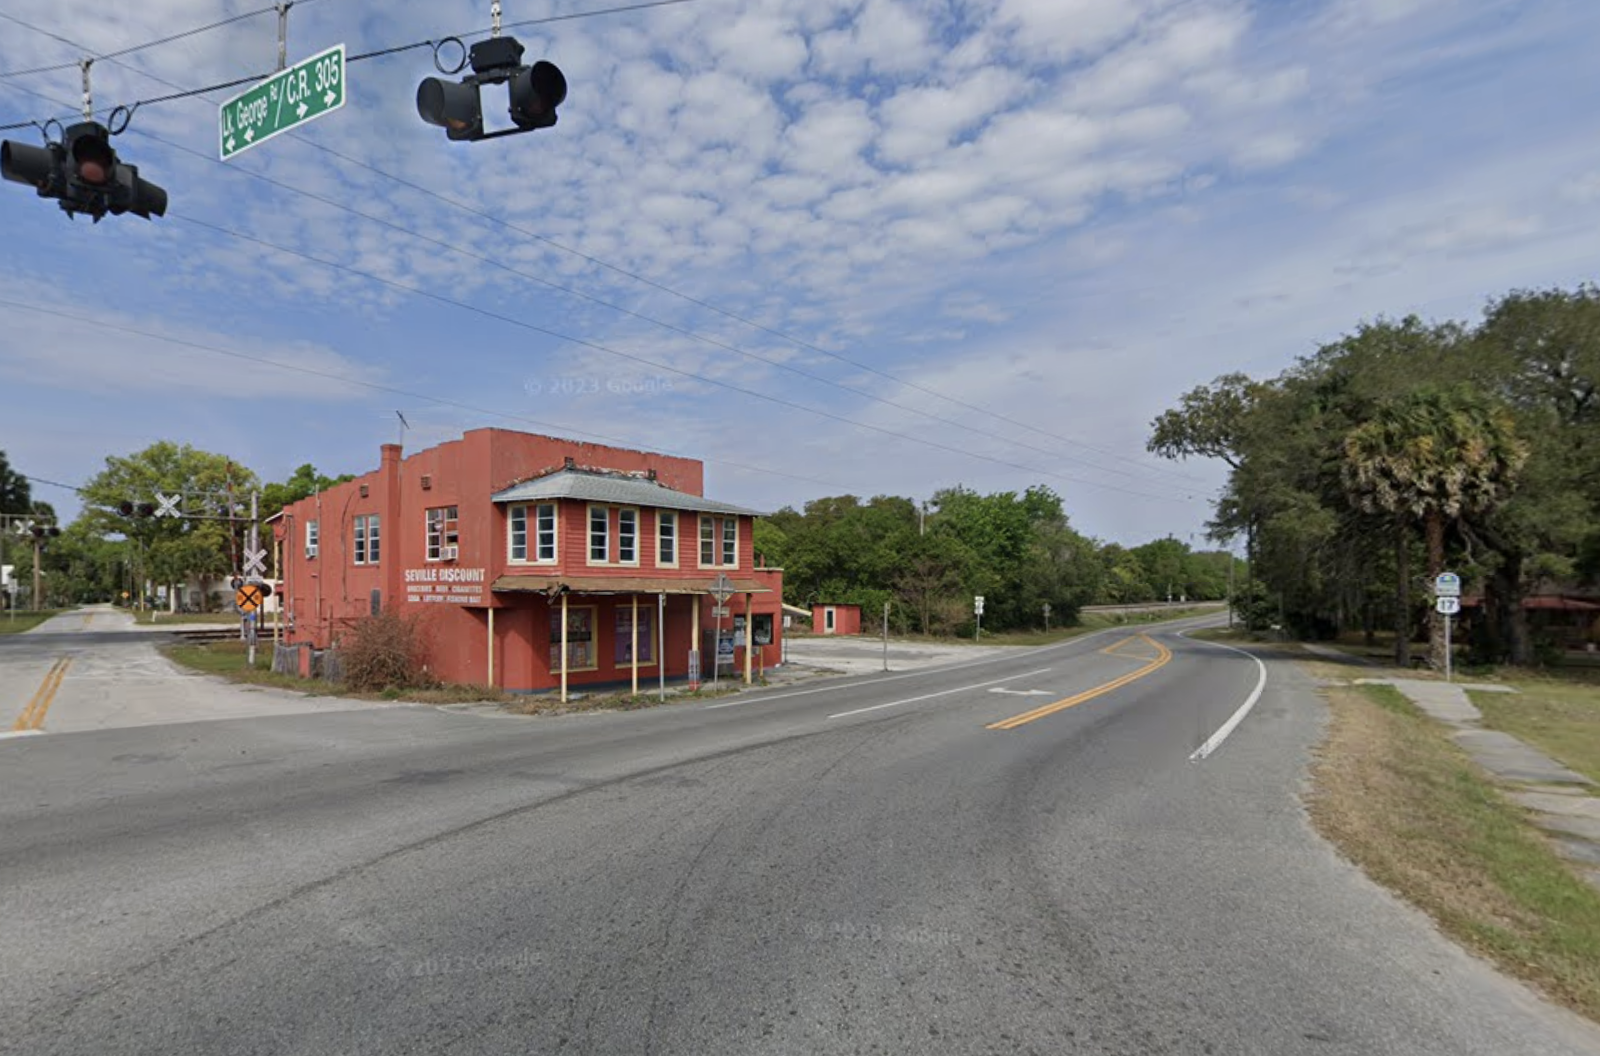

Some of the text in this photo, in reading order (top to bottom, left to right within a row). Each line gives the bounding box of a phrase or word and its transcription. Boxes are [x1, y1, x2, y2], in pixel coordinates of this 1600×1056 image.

[237, 101, 268, 127] George
[287, 69, 311, 105] C.R.
[315, 55, 339, 92] 305
[405, 568, 485, 582] SEVILLE DISCOUNT
[1441, 600, 1456, 611] 17
